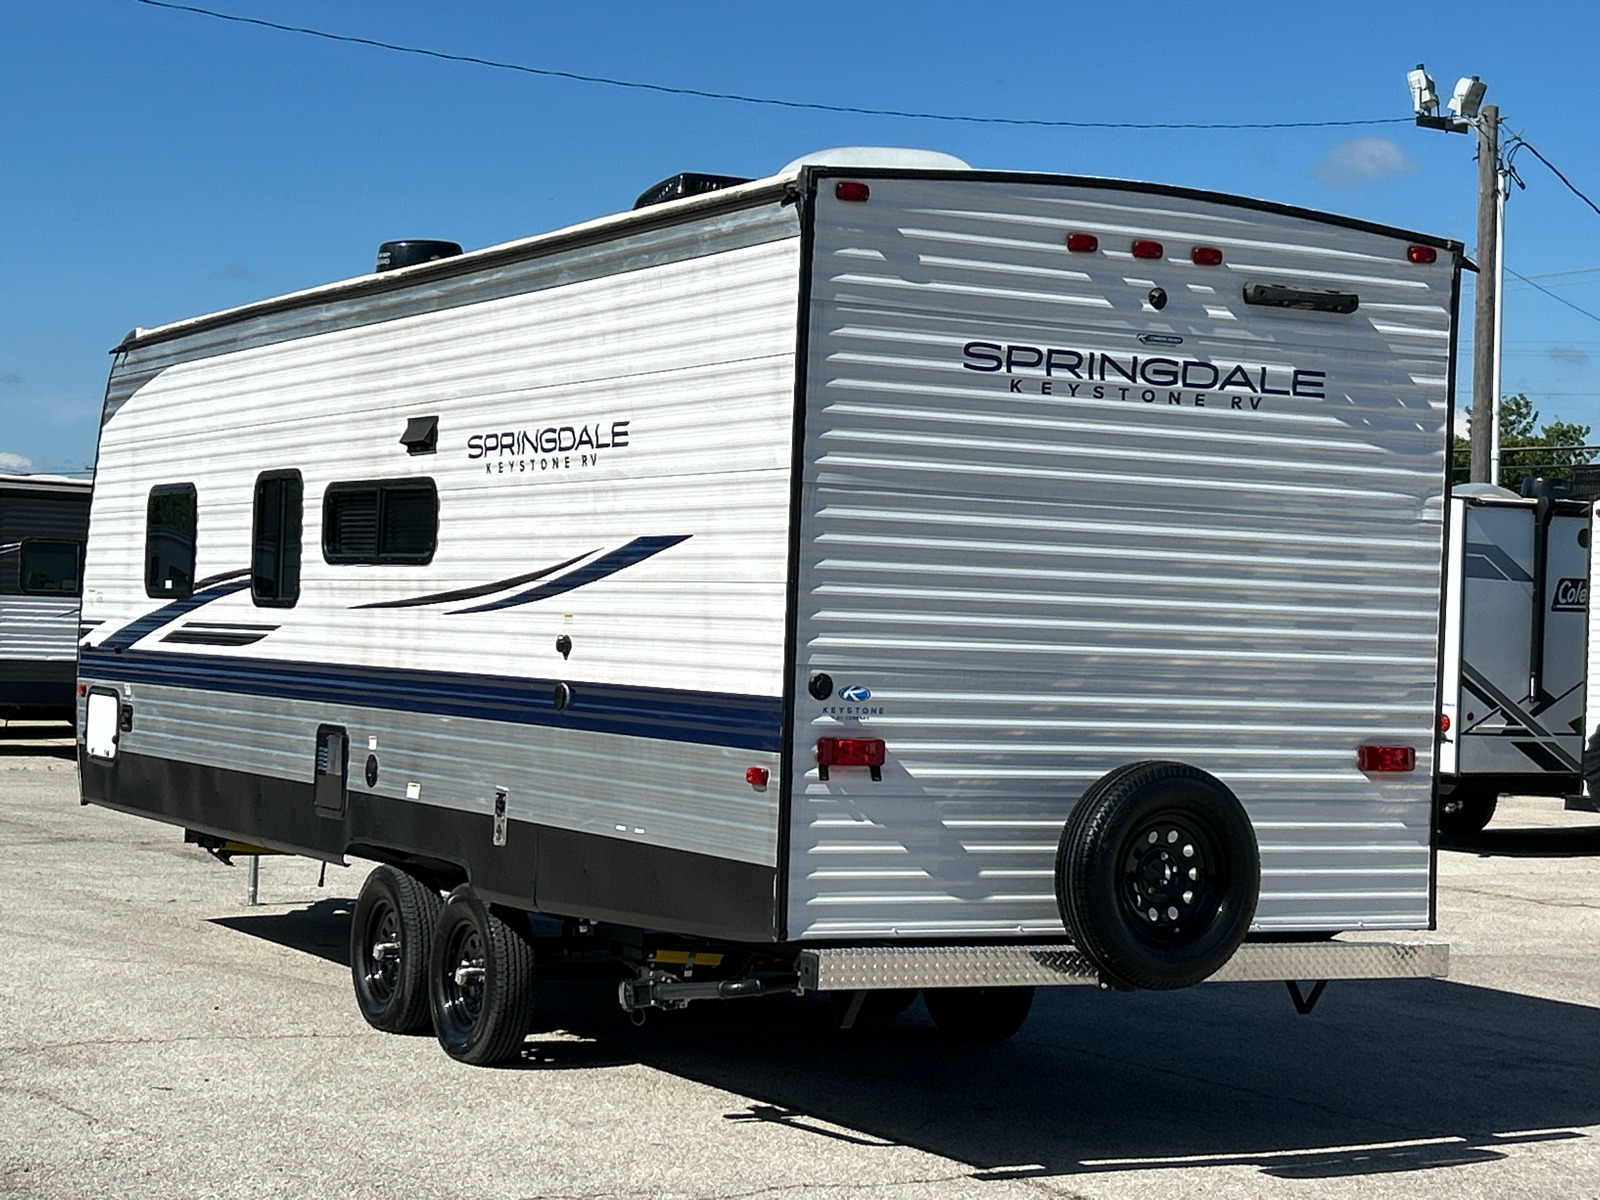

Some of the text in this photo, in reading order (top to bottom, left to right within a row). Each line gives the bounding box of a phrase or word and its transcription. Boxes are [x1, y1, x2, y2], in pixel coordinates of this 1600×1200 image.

[962, 341, 1326, 399] SPRINGDALE
[1009, 378, 1264, 410] KEYSTONE RV
[467, 420, 630, 459] SPRINGDALE
[485, 453, 597, 474] KEYSTONE RV
[822, 706, 884, 715] KEYSTONE
